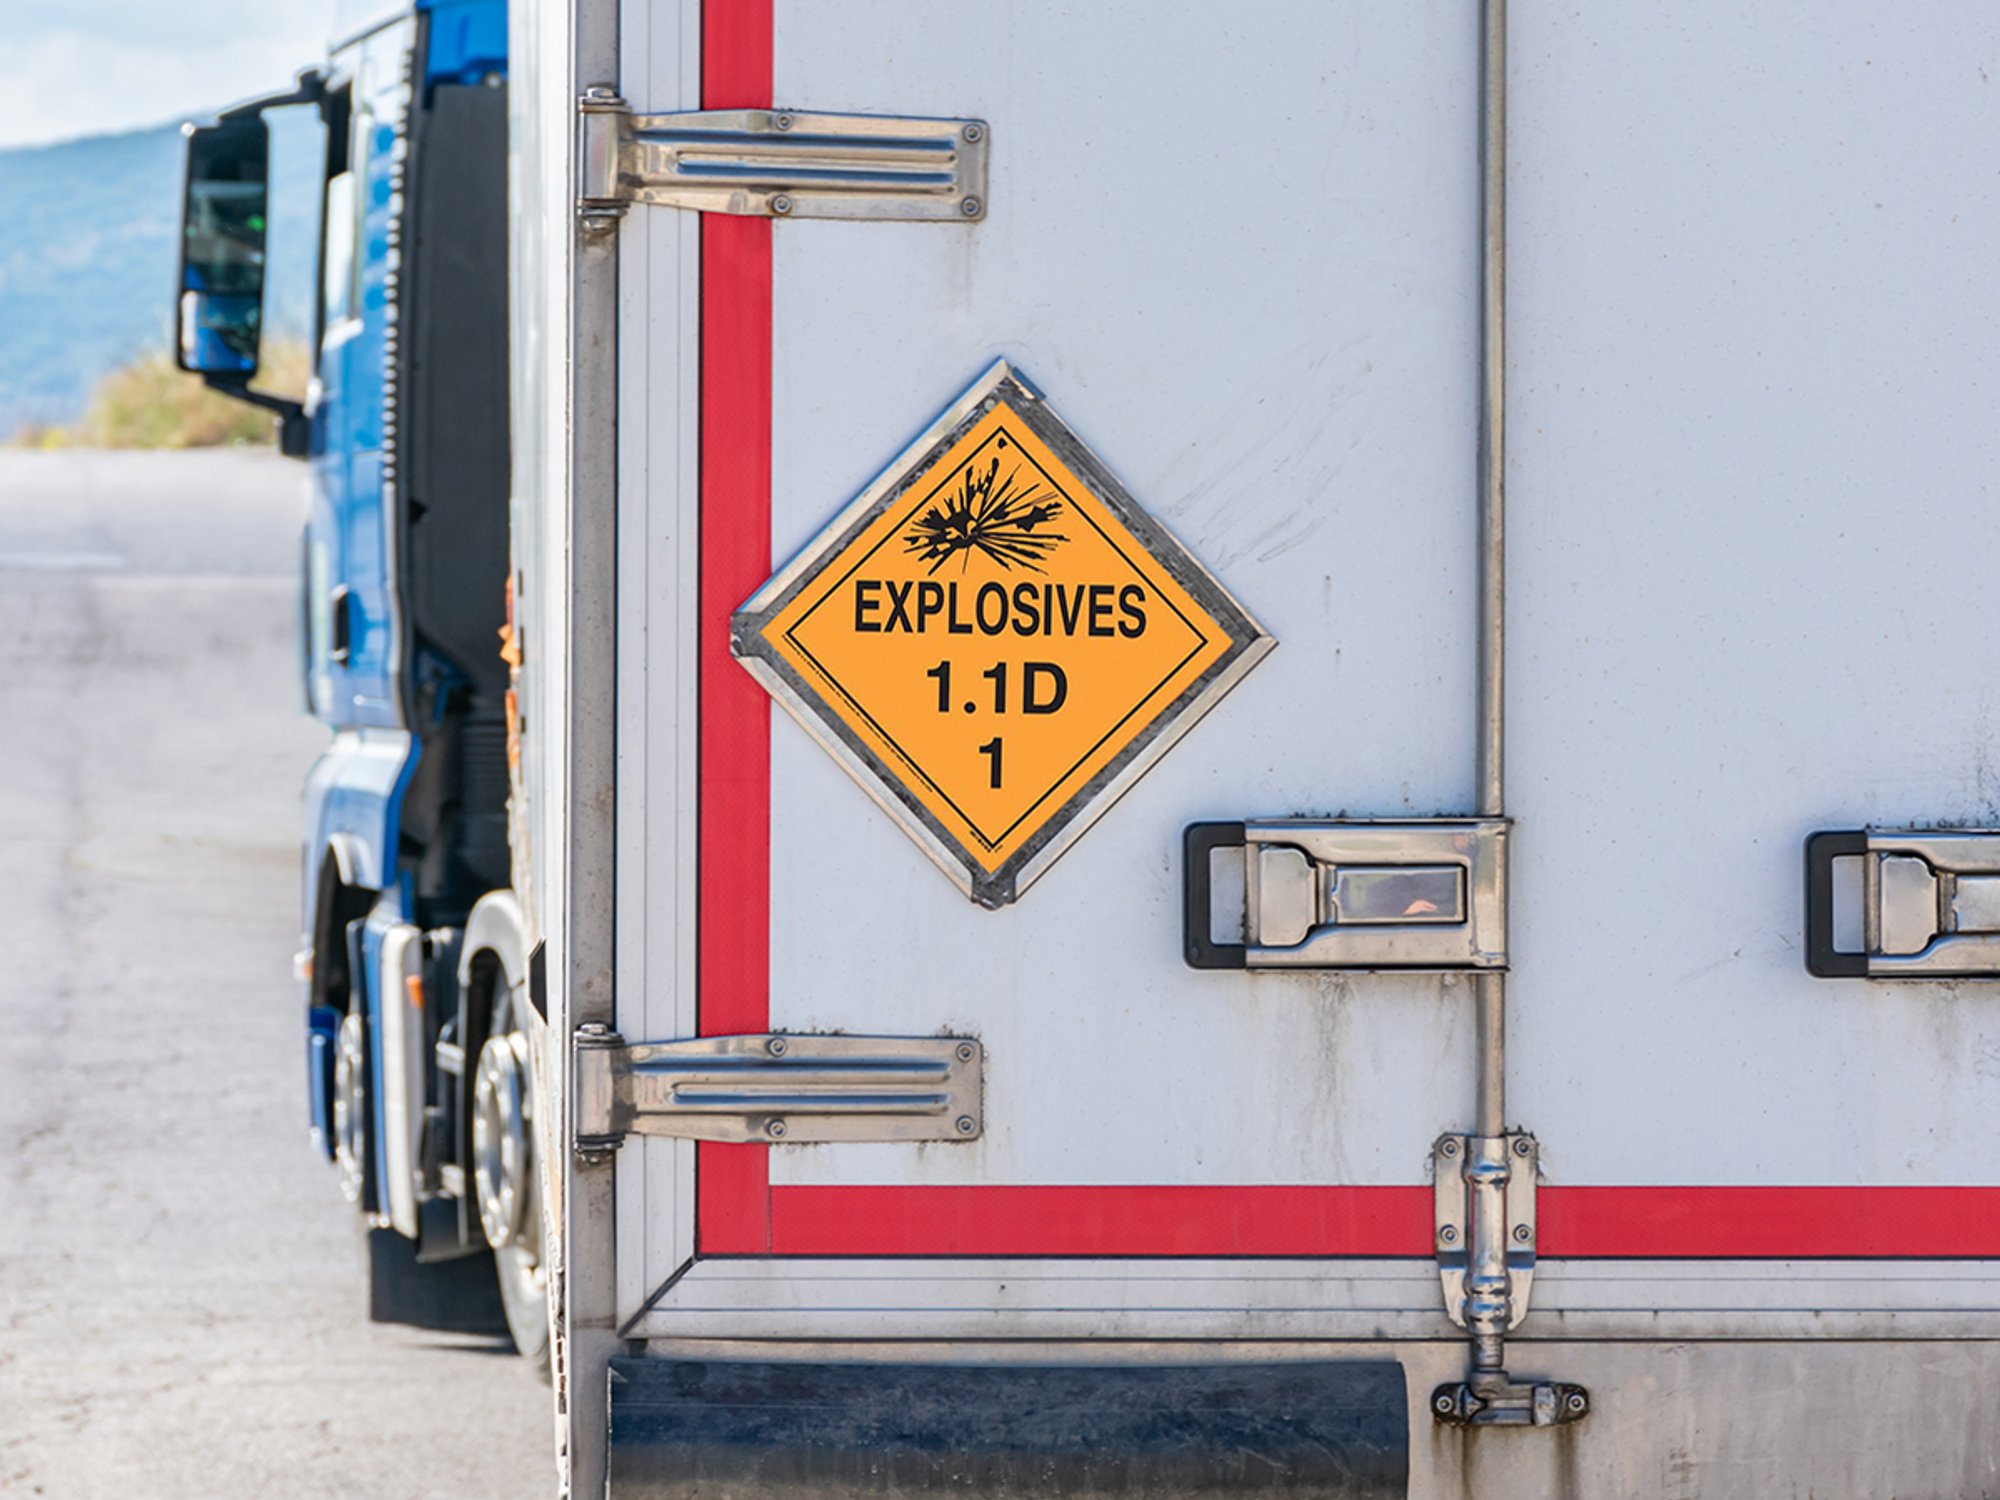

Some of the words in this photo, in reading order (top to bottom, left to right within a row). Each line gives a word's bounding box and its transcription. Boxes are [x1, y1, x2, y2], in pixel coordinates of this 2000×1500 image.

[854, 579, 1147, 639] EXPLOSIVES
[926, 660, 1068, 715] 1.1D
[978, 736, 1003, 789] 1
